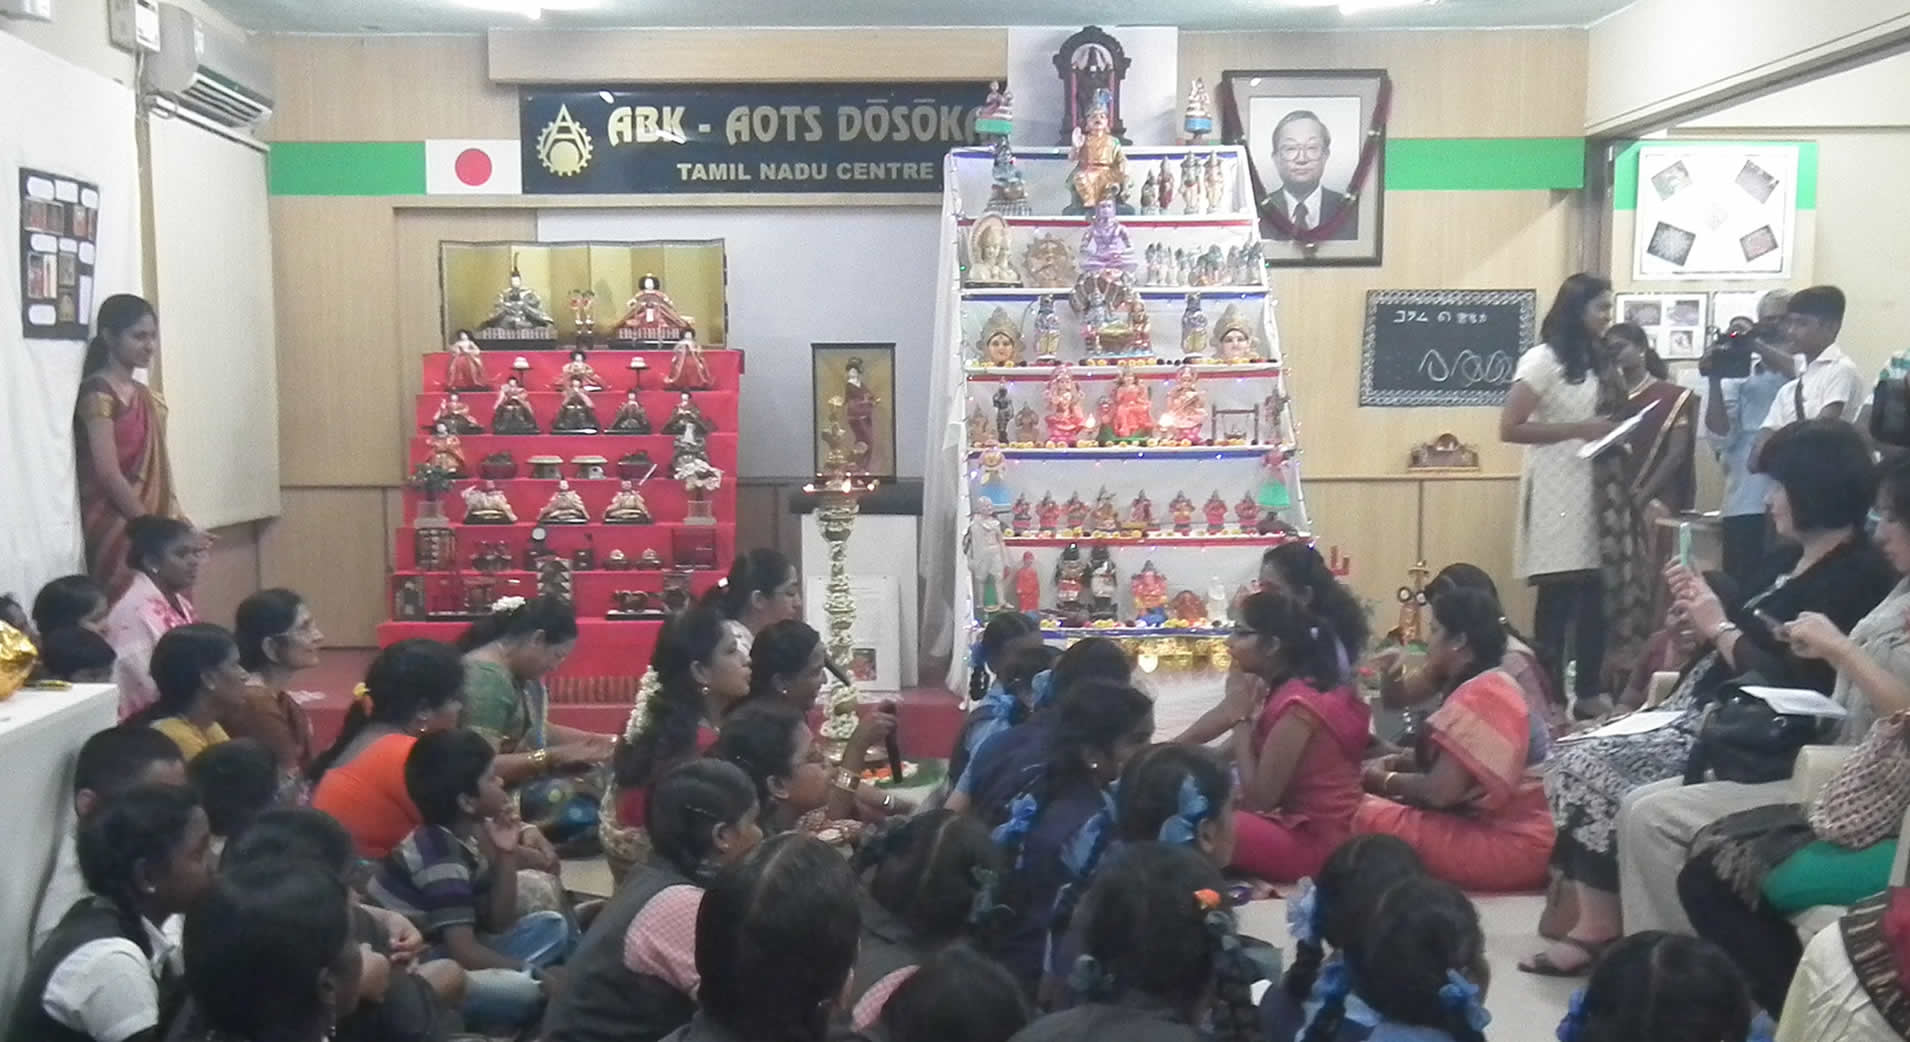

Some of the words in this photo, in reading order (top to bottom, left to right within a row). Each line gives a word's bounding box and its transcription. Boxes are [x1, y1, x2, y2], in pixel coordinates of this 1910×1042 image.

[607, 105, 686, 147] ABK
[725, 105, 822, 146] AOTS
[676, 162, 752, 181] TAMIL
[759, 162, 828, 181] NADU
[835, 161, 935, 181] CENTRE
